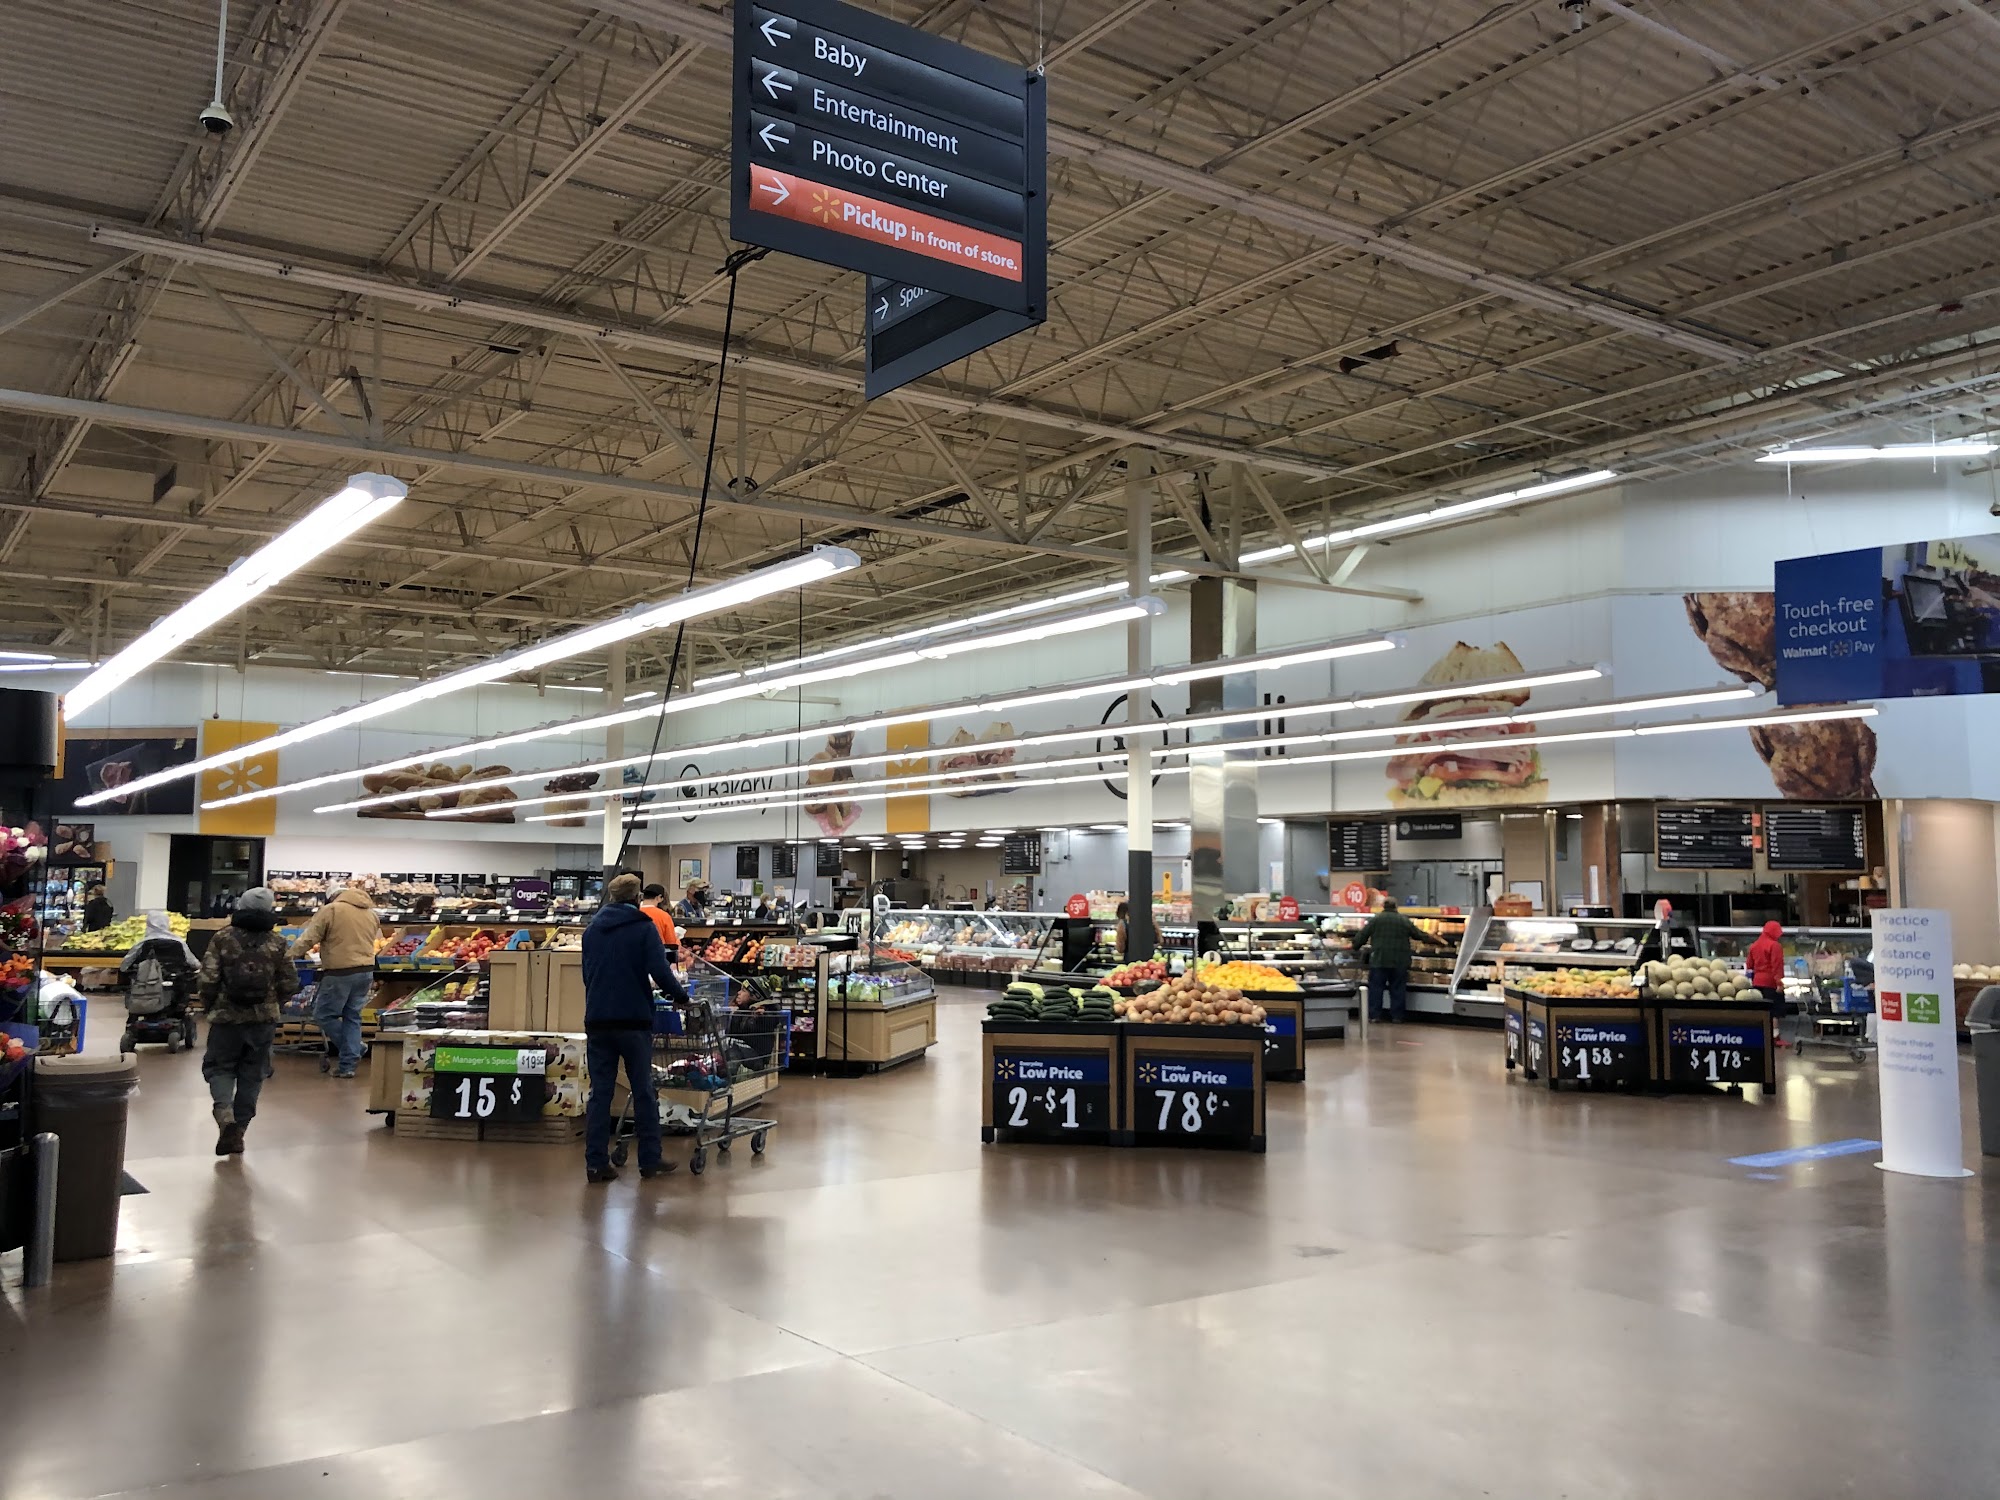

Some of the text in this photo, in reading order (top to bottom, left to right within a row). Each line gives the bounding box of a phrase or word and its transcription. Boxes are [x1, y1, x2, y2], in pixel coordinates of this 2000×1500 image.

[814, 36, 867, 76] Baby
[813, 88, 959, 155] Entertainment
[812, 139, 948, 198] Photo Center
[843, 202, 1018, 271] Pickup in front of store.
[1781, 596, 1875, 619] Touch-free
[1788, 616, 1868, 638] checkout
[1782, 640, 1875, 659] Walmart Pay
[1879, 913, 1929, 926] Practice
[1575, 1030, 1627, 1042] Low Price
[1690, 1033, 1743, 1045] Low Price
[452, 1055, 518, 1066] Manager's Specia
[1019, 1066, 1084, 1080] Low Price
[1161, 1070, 1228, 1084] Low Price
[454, 1077, 496, 1118] 15
[1008, 1086, 1029, 1127] 2
